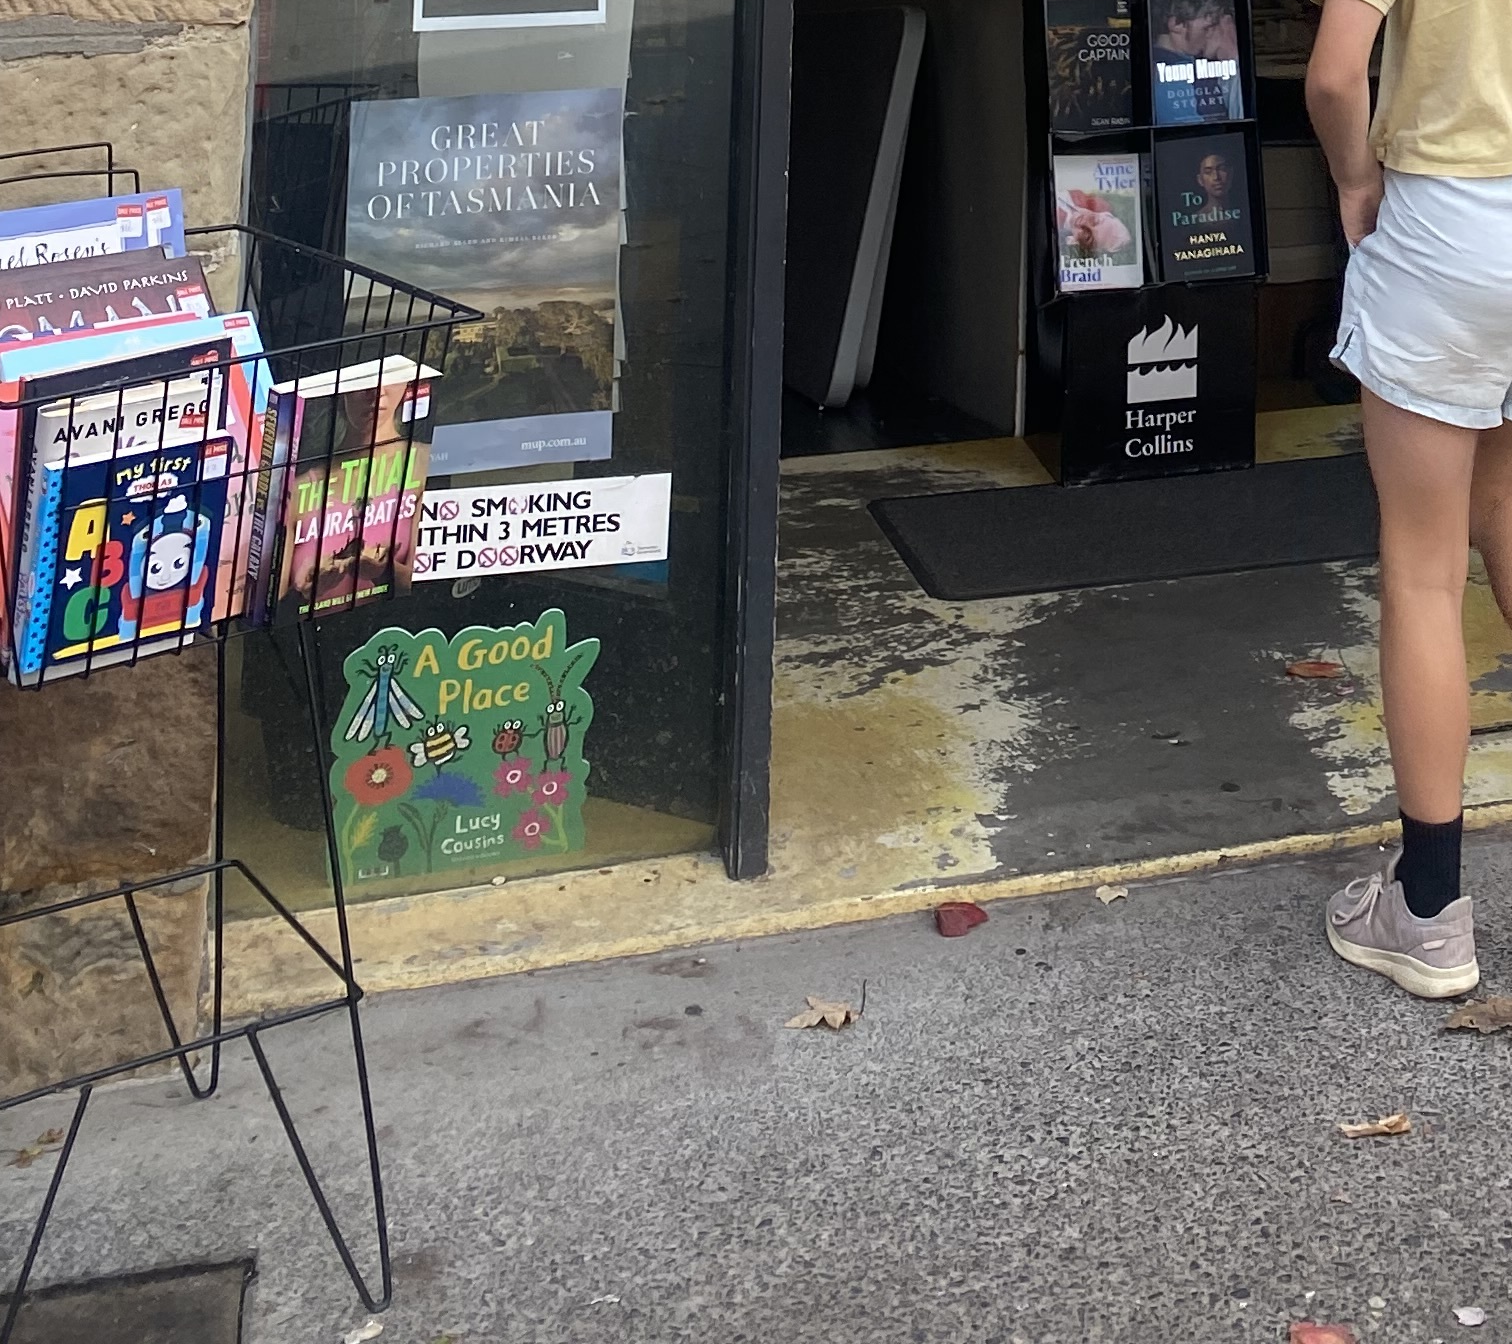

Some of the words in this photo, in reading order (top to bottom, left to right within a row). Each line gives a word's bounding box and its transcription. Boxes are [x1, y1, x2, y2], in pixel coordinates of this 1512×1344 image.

[1086, 33, 1131, 47] GOOD
[1077, 48, 1131, 63] CAPTAIN
[1156, 61, 1196, 84] Young
[1195, 58, 1237, 81] Mungo
[1167, 86, 1230, 100] DOUGLAS
[1172, 97, 1224, 110] STUART
[430, 119, 545, 152] GREAT
[377, 149, 596, 188] PROPERTIES
[1092, 162, 1135, 177] Anne
[1095, 176, 1136, 194] Tyler
[367, 193, 414, 221] OF
[421, 181, 601, 218] TASMANIA
[1180, 191, 1203, 208] To
[1171, 205, 1242, 227] Paradise
[481, 237, 497, 245] AND
[1189, 231, 1228, 246] HANYA
[1061, 253, 1113, 269] French
[1173, 244, 1245, 262] YANAGIHARA
[1060, 268, 1102, 284] Braid
[5, 292, 53, 310] PLATT
[69, 281, 118, 300] DAVID
[122, 269, 189, 291] PARKINS
[53, 415, 125, 445] AVANI
[1125, 409, 1197, 432] Harper
[520, 436, 587, 452] mup.com.au
[1124, 434, 1194, 458] Collins
[115, 462, 145, 486] my
[149, 455, 192, 473] first
[297, 476, 339, 515] THE
[340, 446, 422, 505] TRIAL
[133, 477, 173, 492] THOAS
[365, 493, 417, 527] BATES
[420, 500, 460, 523] NO
[471, 490, 593, 518] SMOKING
[65, 498, 111, 561] A
[416, 520, 489, 547] ITHIN
[498, 521, 511, 541] 3
[521, 513, 621, 539] METRES
[90, 540, 124, 587] B
[412, 551, 447, 574] OF
[456, 539, 594, 570] DOORWAY
[63, 586, 111, 641] C
[412, 644, 440, 678] A
[457, 624, 554, 671] Good
[439, 678, 530, 715] Place
[455, 812, 501, 834] Lucy
[440, 833, 505, 855] Cousins
